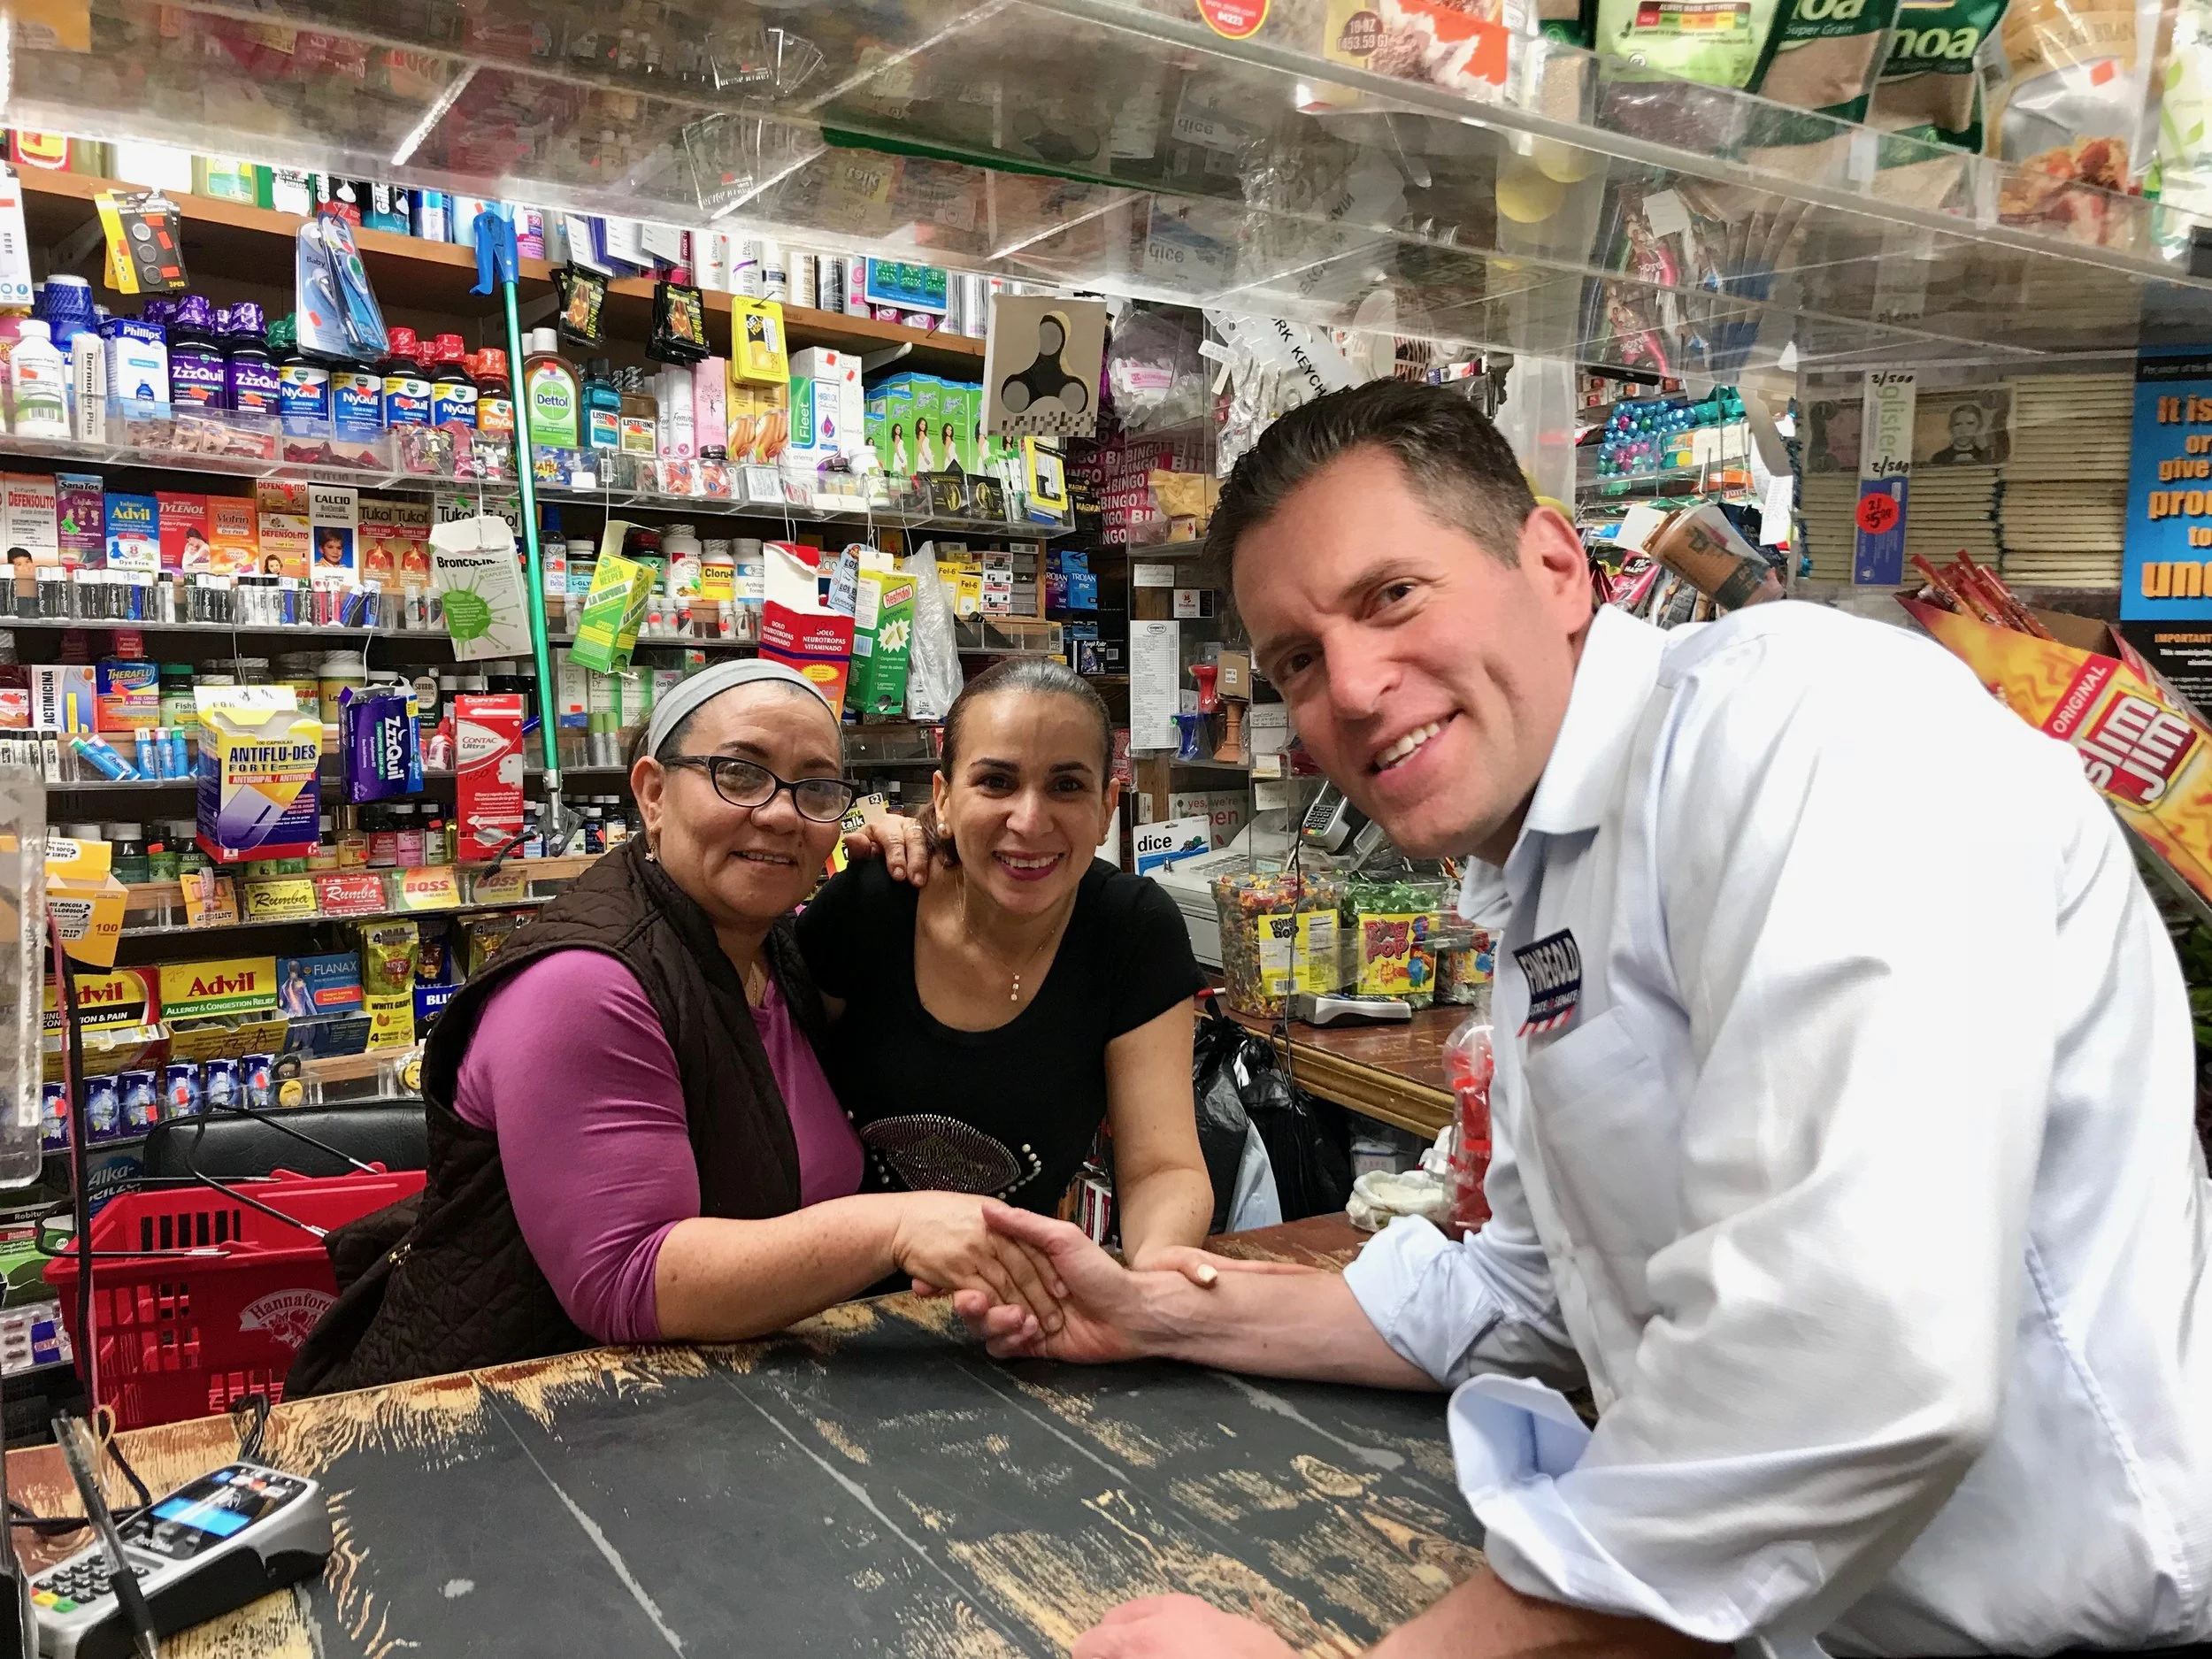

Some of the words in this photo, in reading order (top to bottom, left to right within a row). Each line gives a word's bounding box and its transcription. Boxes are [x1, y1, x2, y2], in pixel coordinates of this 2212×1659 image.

[306, 256, 326, 268] Baby
[173, 363, 225, 383] ZzzQuil
[342, 391, 379, 406] NyQuil
[537, 394, 568, 407] Dettol
[442, 402, 476, 416] NyQuil
[2157, 395, 2181, 424] It
[623, 419, 655, 429] LISTERINE
[799, 402, 810, 438] Fleet
[1876, 385, 1905, 457] glister
[1125, 442, 1163, 460] BINGO
[2158, 456, 2210, 482] give
[60, 480, 100, 491] SanaTos
[8, 491, 55, 510] DEFENSOLITO
[315, 494, 351, 505] CALCIO
[1101, 493, 1138, 511] BINGO
[111, 506, 150, 521] Advil
[157, 502, 205, 514] TYLENOL
[360, 507, 392, 522] Tukol
[938, 566, 957, 575] Fel-6
[1045, 572, 1068, 582] ROJAN
[1071, 572, 1096, 583] TROJAN
[599, 572, 625, 587] HELPER
[960, 580, 978, 589] Fel-6
[885, 585, 911, 607] Restridol
[771, 620, 786, 630] DOLO
[763, 634, 791, 648] VITAMINADO
[803, 636, 846, 645] NEUROTROPAS
[804, 643, 842, 652] VITAMINADO
[107, 668, 153, 680] THERAFLU
[42, 670, 56, 725] ACTIMICINA
[2052, 664, 2108, 735] ORIGINAL
[462, 735, 498, 745] CONTAC
[229, 744, 317, 764] ANTIFLU-DES
[385, 717, 404, 781] ZzzQuil
[229, 764, 279, 772] FORTE
[232, 775, 273, 784] ANTIGRIPAL
[280, 772, 312, 782] ANTIVIRAL
[1187, 799, 1208, 810] yes,
[1210, 797, 1239, 808] we're
[1137, 834, 1172, 853] dice
[326, 884, 378, 902] Rumba
[405, 879, 449, 893] BOSS
[254, 890, 309, 909] Rumba
[96, 923, 119, 933] 100
[476, 926, 484, 934] 4
[1363, 918, 1409, 936] Ring
[373, 933, 382, 944] 4
[313, 959, 357, 976] FLANAX
[187, 972, 256, 999] Advil
[58, 981, 124, 1005] dvil
[166, 1006, 200, 1016] ALLERGY
[206, 999, 252, 1010] CONGESTION
[252, 997, 276, 1007] RELIEF
[372, 1002, 394, 1010] WHITE
[395, 998, 411, 1010] GRAPE
[426, 995, 449, 1006] BLU
[1529, 1001, 1548, 1016] STATE
[1555, 989, 1578, 1008] SENATE
[107, 1011, 128, 1021] PAIN
[371, 1033, 380, 1043] 4
[88, 1164, 134, 1187] Alka-
